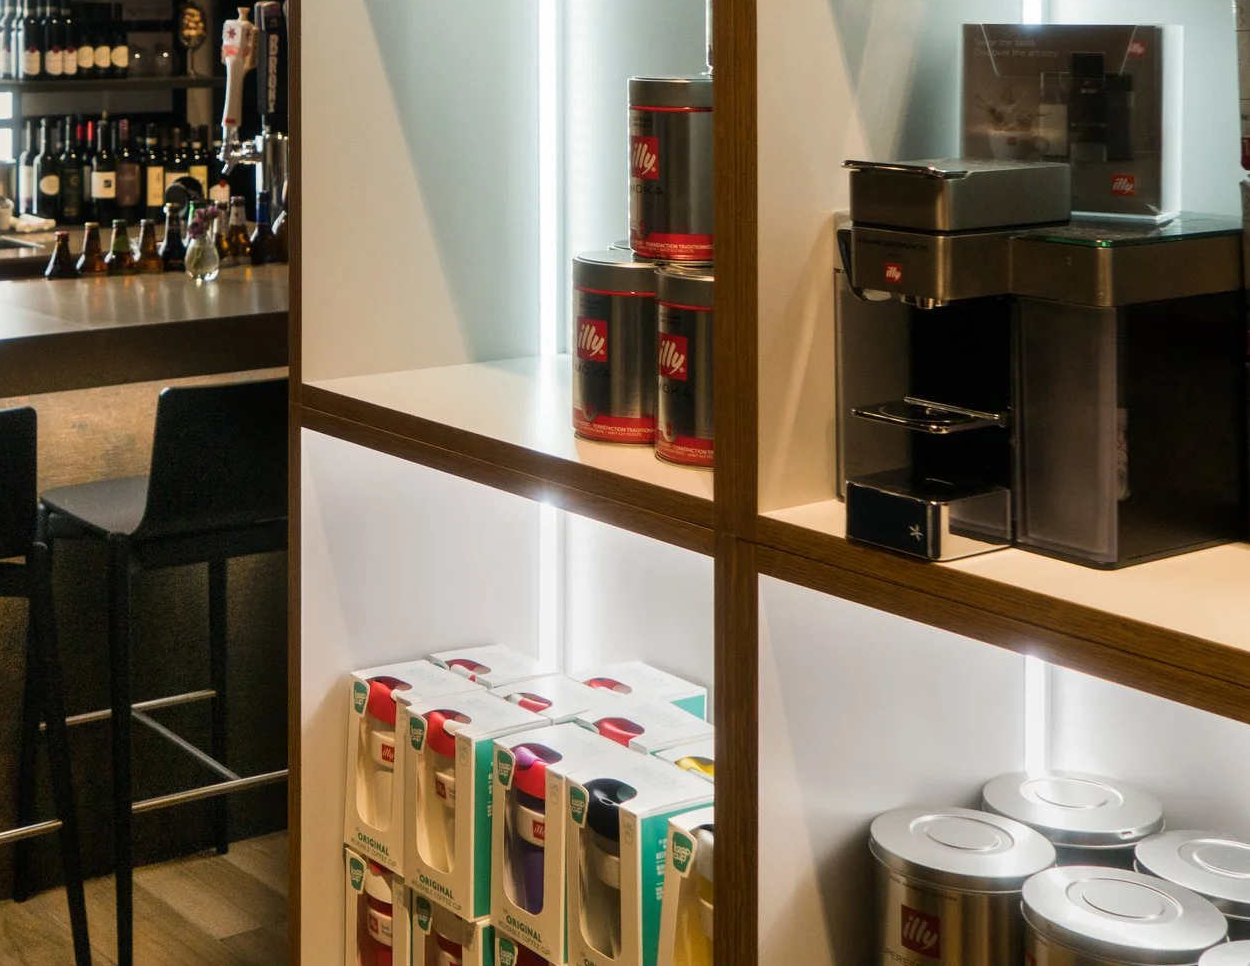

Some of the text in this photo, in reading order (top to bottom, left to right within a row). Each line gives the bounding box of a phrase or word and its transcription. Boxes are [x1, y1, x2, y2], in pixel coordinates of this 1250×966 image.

[267, 34, 279, 113] BRONX
[631, 143, 657, 175] illy
[1113, 177, 1134, 193] illy
[885, 266, 901, 281] illy
[578, 324, 606, 357] illy
[659, 339, 686, 375] illy
[357, 832, 390, 856] ORIGINAL
[673, 841, 692, 856] keep
[672, 852, 687, 865] cup
[419, 874, 454, 899] ORIGINAL
[506, 915, 543, 944] ORIGINAL
[902, 915, 939, 951] illy
